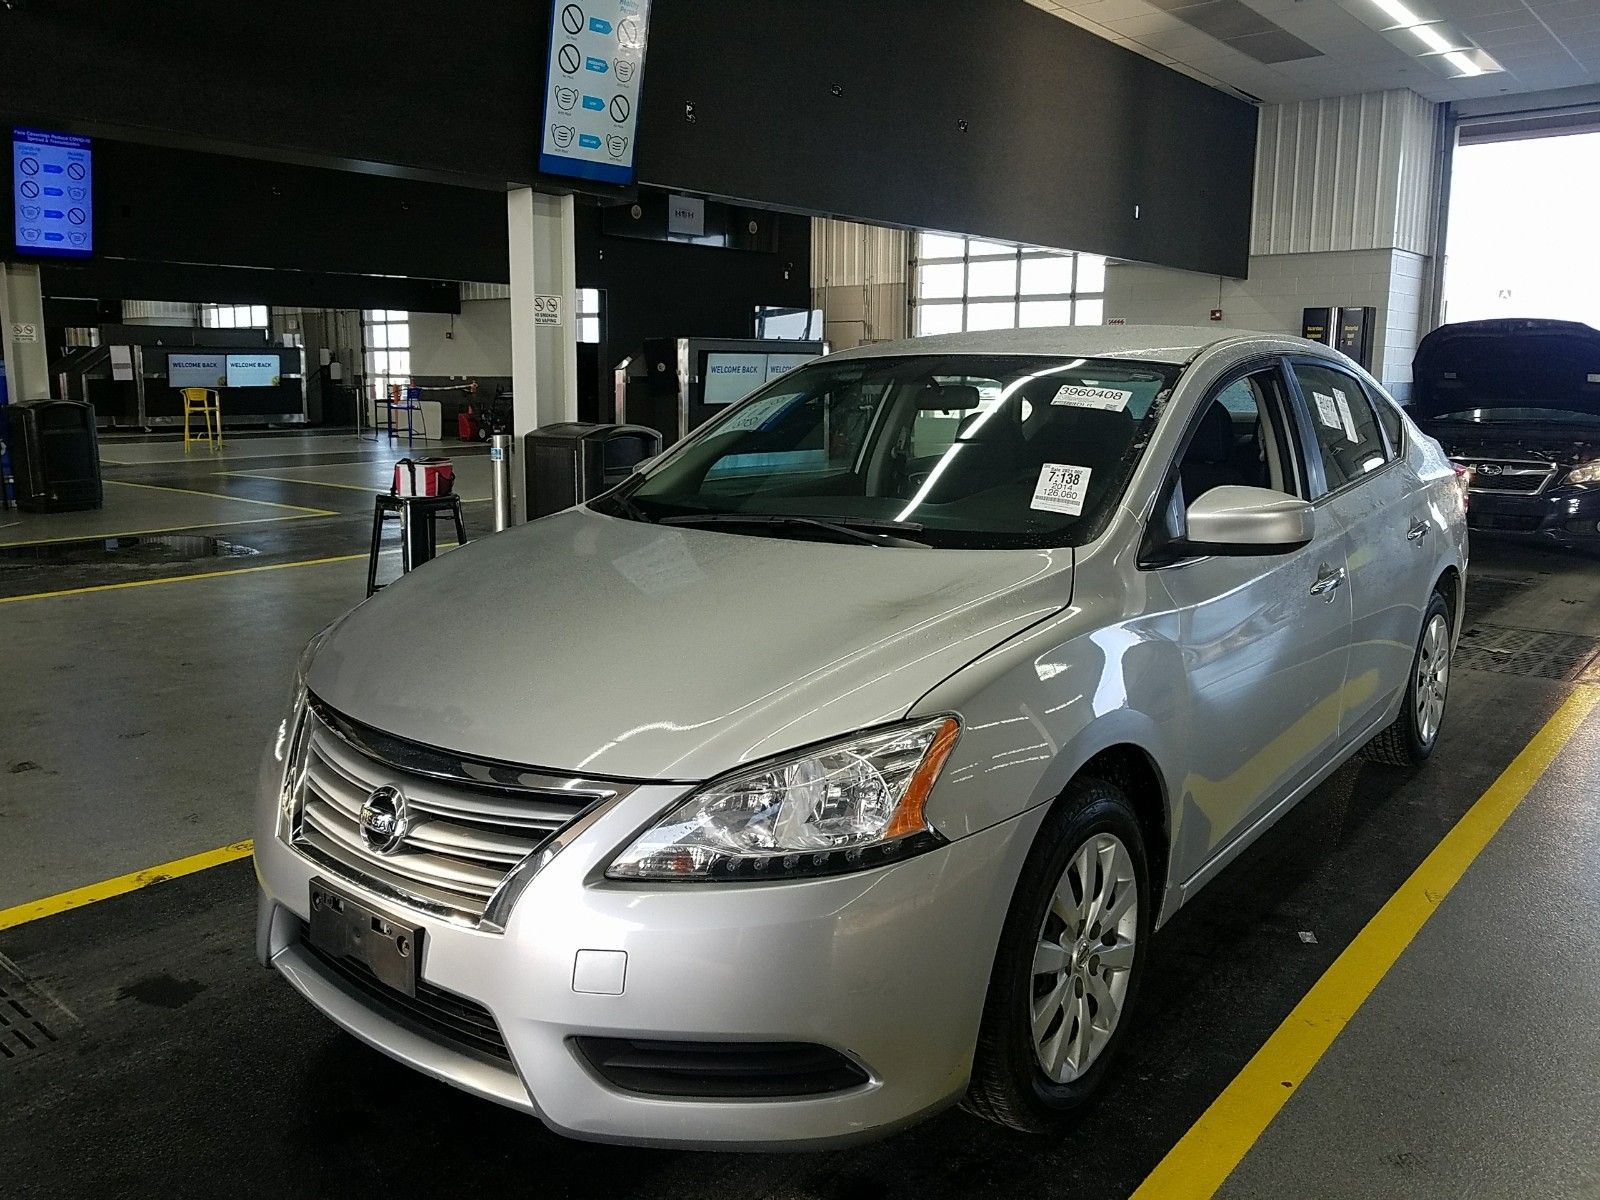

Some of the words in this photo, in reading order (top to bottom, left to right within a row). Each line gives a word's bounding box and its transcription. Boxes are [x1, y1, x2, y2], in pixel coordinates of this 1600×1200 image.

[710, 365, 742, 374] WELCOME
[742, 365, 758, 374] BACK
[1059, 386, 1123, 400] 3960408
[1048, 471, 1080, 486] 7:138
[1051, 482, 1073, 490] 2014
